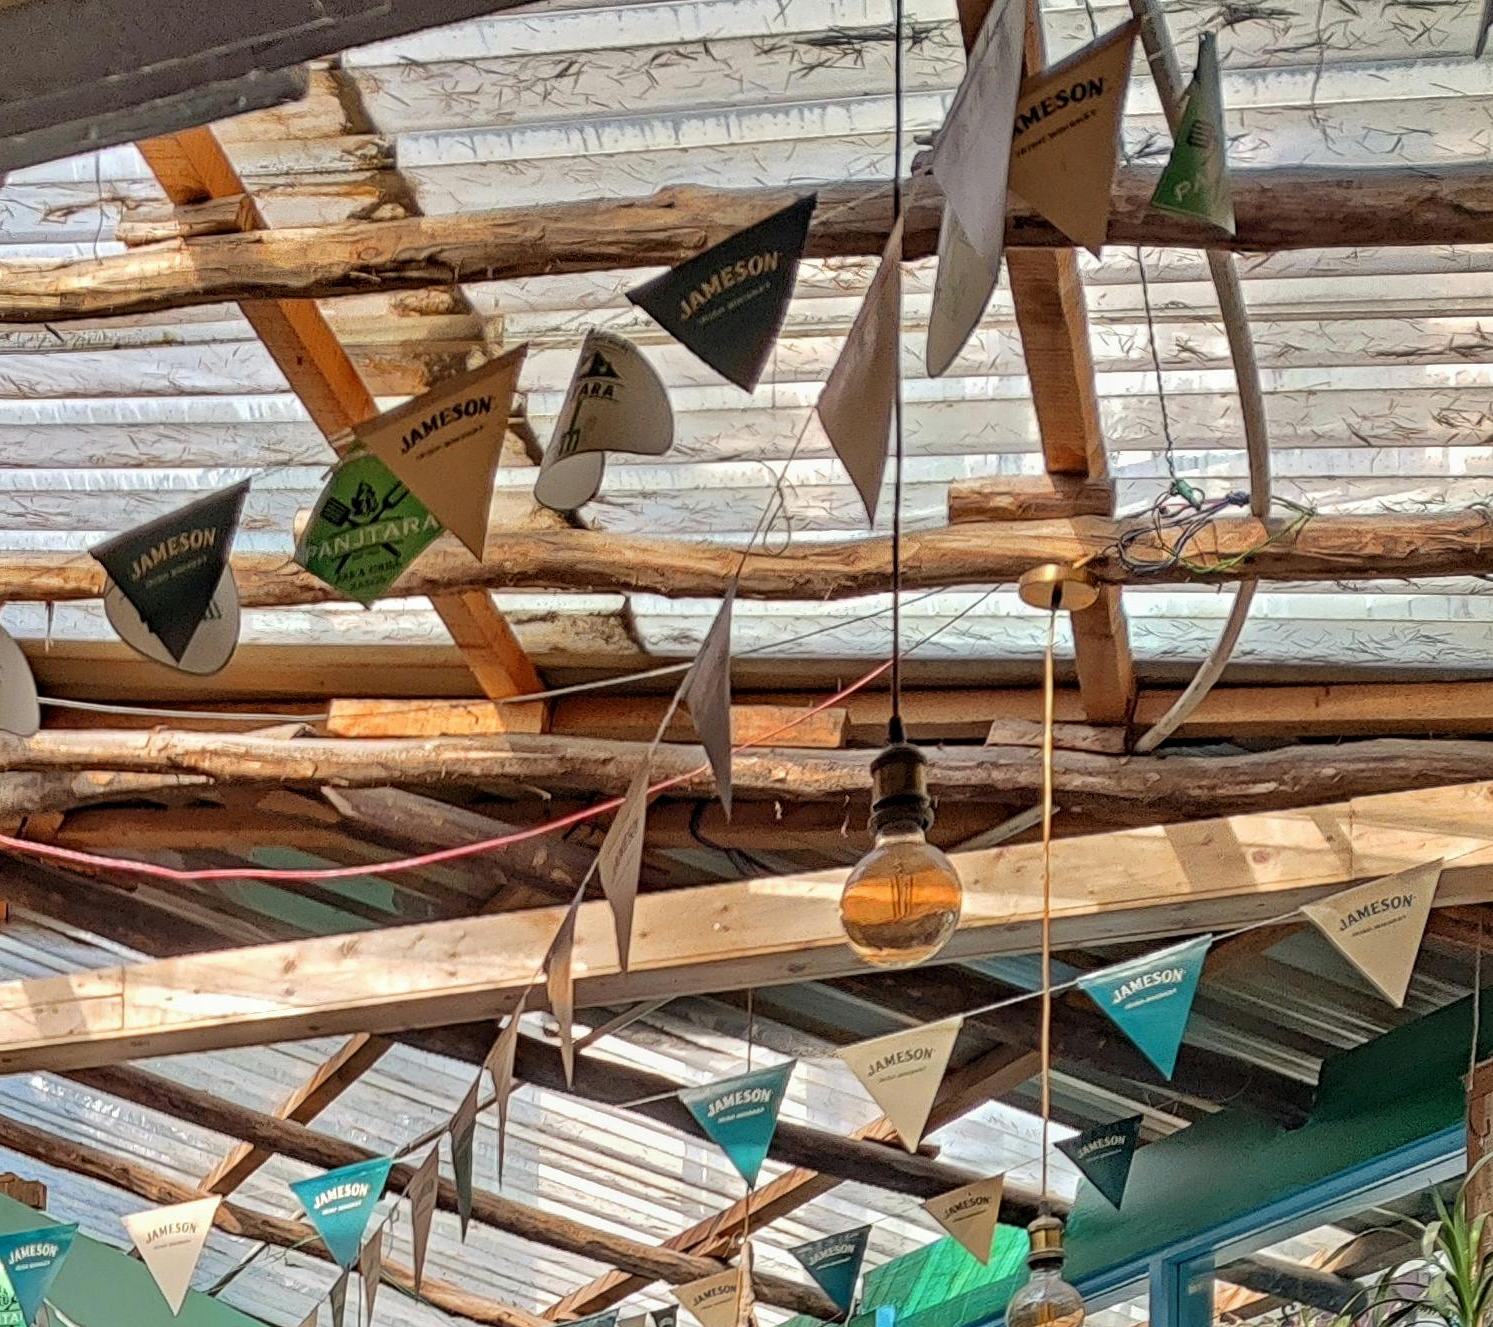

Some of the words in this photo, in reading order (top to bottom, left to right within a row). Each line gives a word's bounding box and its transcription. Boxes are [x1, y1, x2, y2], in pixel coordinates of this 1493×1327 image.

[1014, 78, 1104, 138] AMESON
[680, 250, 779, 321] JAMESON
[401, 395, 493, 455] JAMESON
[131, 527, 218, 582] JAMESON
[1340, 893, 1414, 932] JAMESON
[1113, 967, 1185, 1005] JAMESON
[868, 1047, 934, 1077] JAMESON
[709, 1087, 772, 1118] JAMESON
[1079, 1134, 1127, 1158] JAMESON
[313, 1183, 369, 1210] JAMESON
[945, 1196, 990, 1218] JAMESON
[146, 1222, 197, 1245] JAMESON
[9, 1243, 59, 1266] JAMESON
[810, 1244, 855, 1264] JAMESON
[694, 1284, 738, 1305] JAMESON
